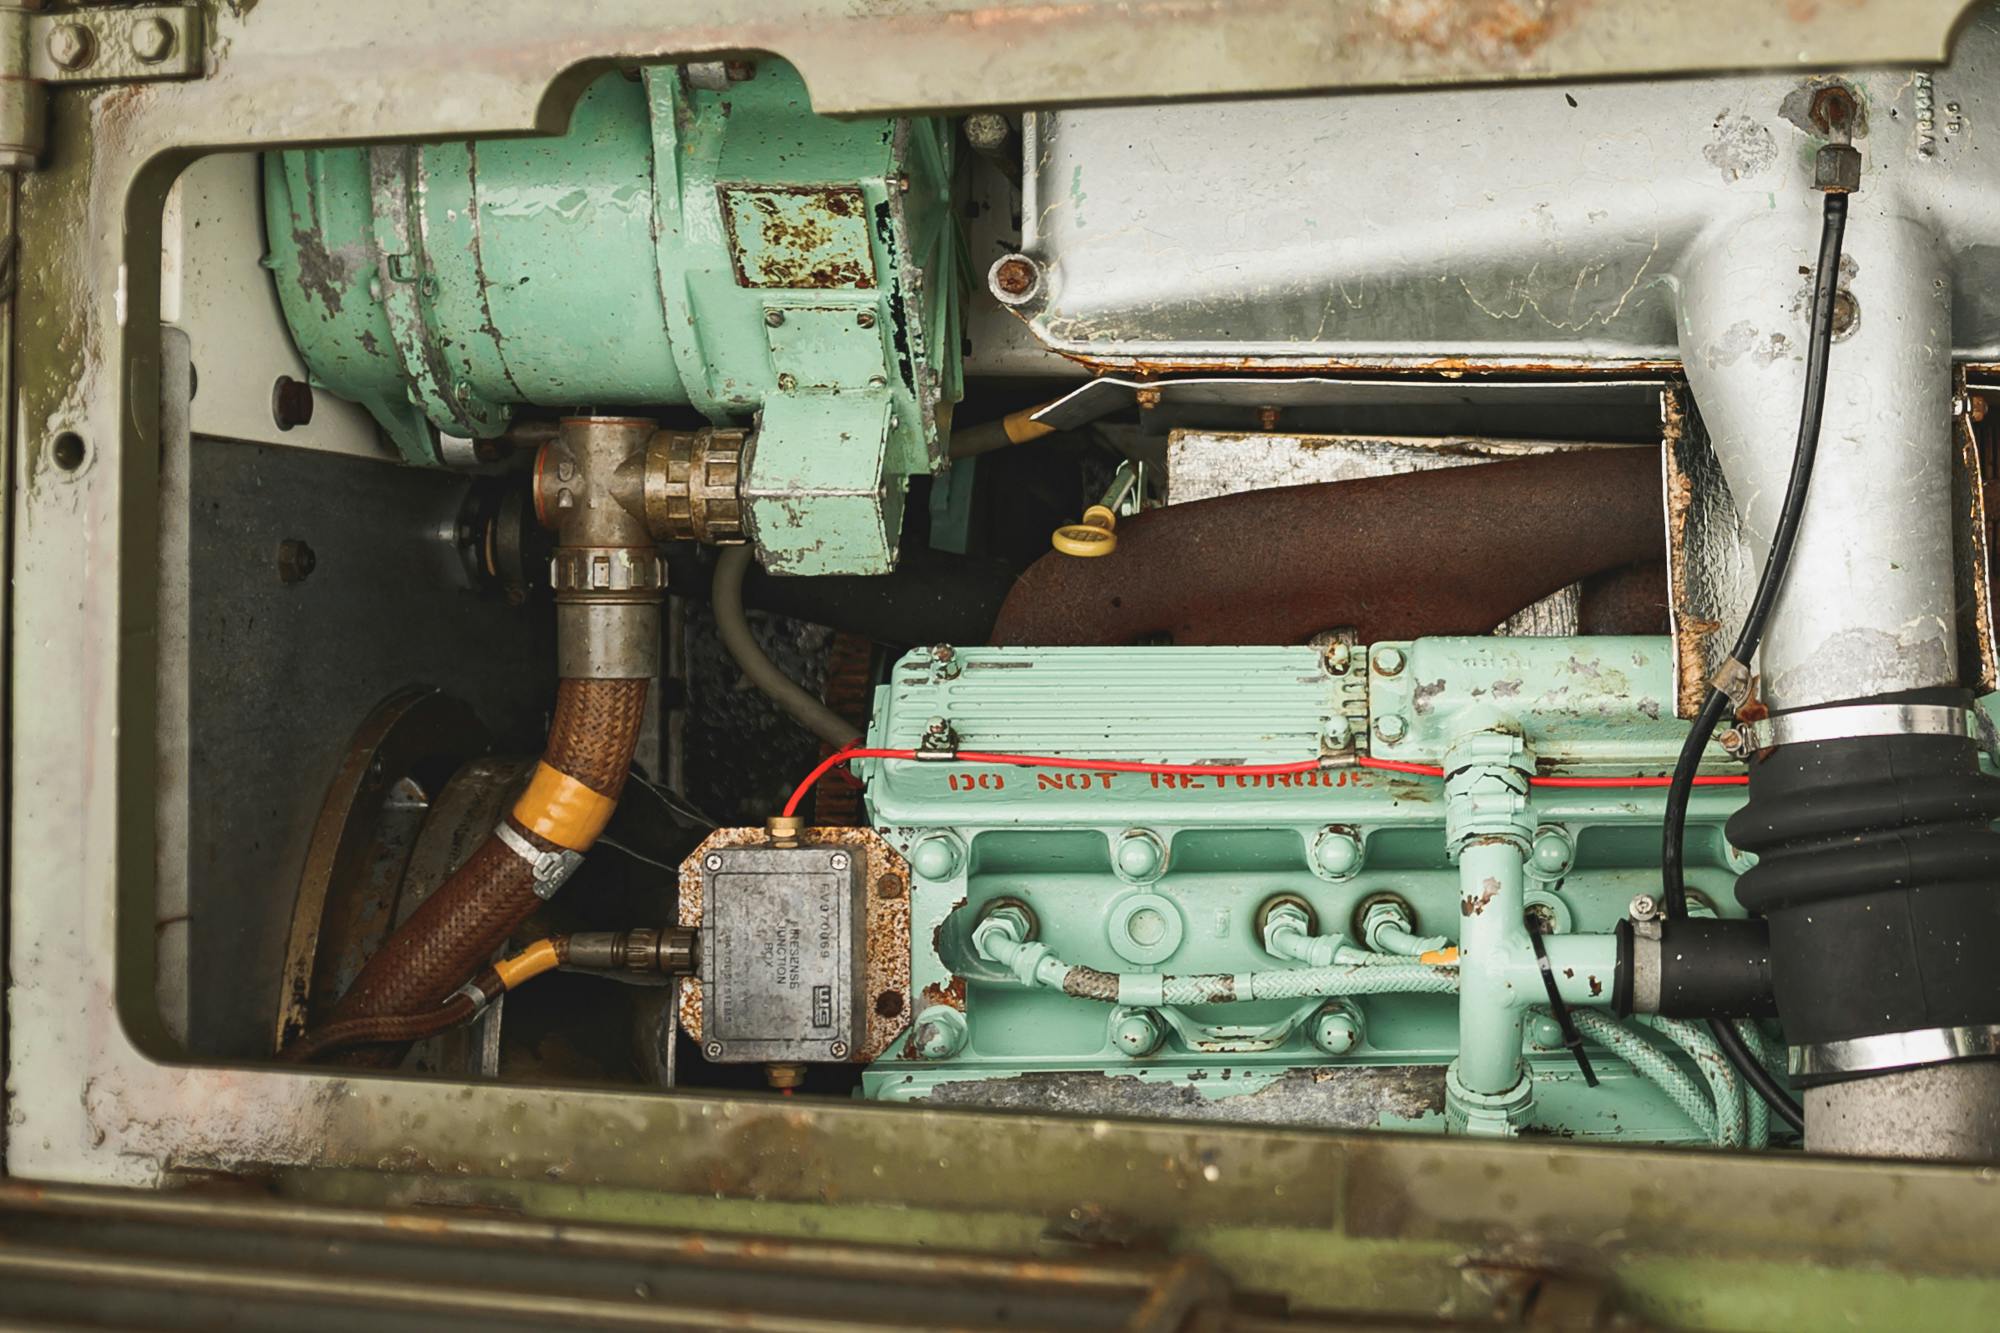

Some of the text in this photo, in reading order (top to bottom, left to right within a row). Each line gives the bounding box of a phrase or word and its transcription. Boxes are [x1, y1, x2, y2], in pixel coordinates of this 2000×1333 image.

[949, 773, 1005, 791] DO
[1037, 772, 1118, 790] NOT
[764, 942, 774, 968] BOX
